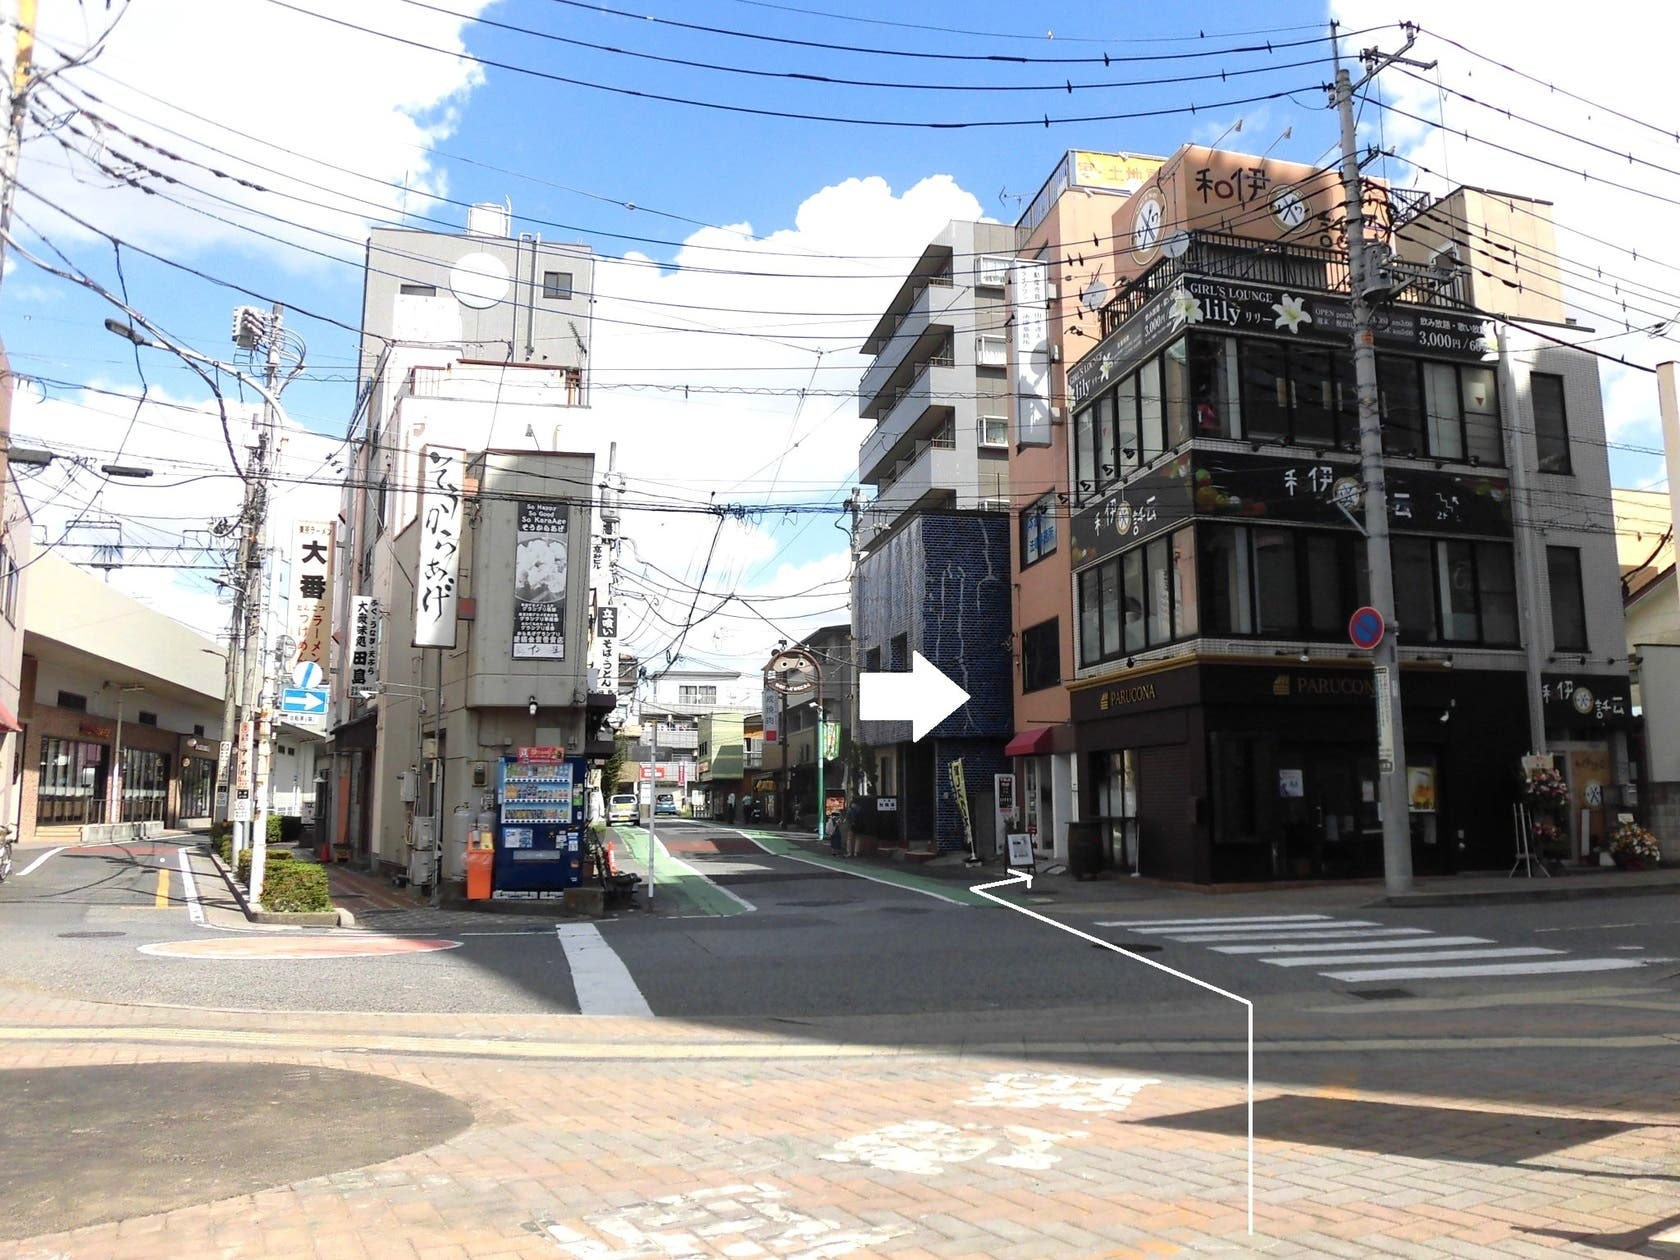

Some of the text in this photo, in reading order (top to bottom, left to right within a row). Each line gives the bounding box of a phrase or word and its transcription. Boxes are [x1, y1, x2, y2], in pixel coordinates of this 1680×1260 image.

[1196, 167, 1271, 204] 和伊
[1190, 282, 1273, 303] GIRL'S LOUNGE
[1204, 298, 1273, 326] lily リリー
[1075, 378, 1091, 401] lily
[521, 515, 532, 523] So
[538, 510, 555, 518] Good
[300, 540, 328, 600] 大番
[311, 614, 322, 663] ラーメン
[352, 651, 367, 685] 田島
[1110, 683, 1156, 706] PARUCONA
[1296, 677, 1375, 697] PARUCON
